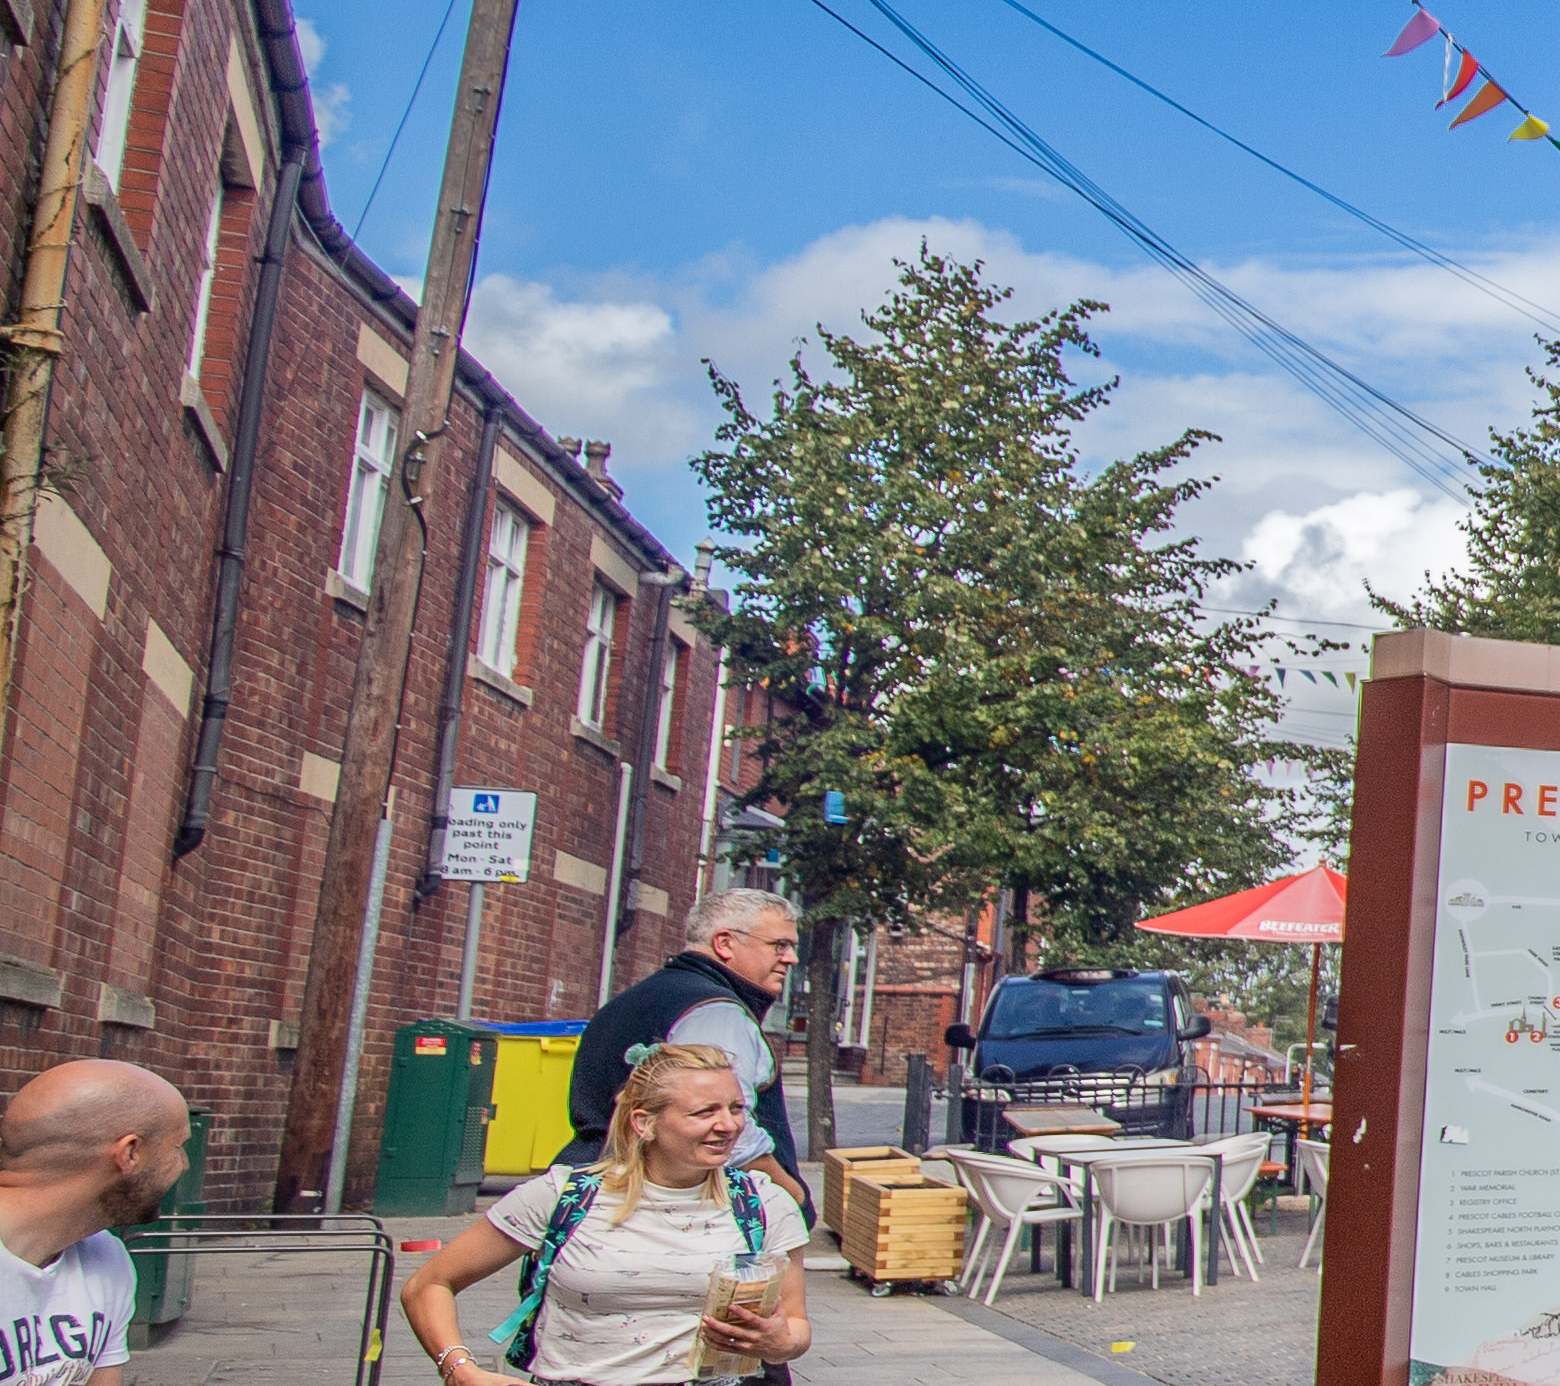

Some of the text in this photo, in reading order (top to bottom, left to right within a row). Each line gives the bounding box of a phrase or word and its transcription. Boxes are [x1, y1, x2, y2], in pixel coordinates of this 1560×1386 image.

[448, 818, 527, 830] oading only
[452, 830, 513, 839] past this
[463, 840, 499, 850] point
[447, 853, 477, 863] Mon
[488, 855, 512, 865] Sat
[453, 867, 472, 875] am
[484, 867, 492, 875] 6
[1258, 919, 1340, 933] BEEFEATER
[1457, 1227, 1505, 1235] SHAKESPEARE
[1483, 1269, 1519, 1277] SHOPPING
